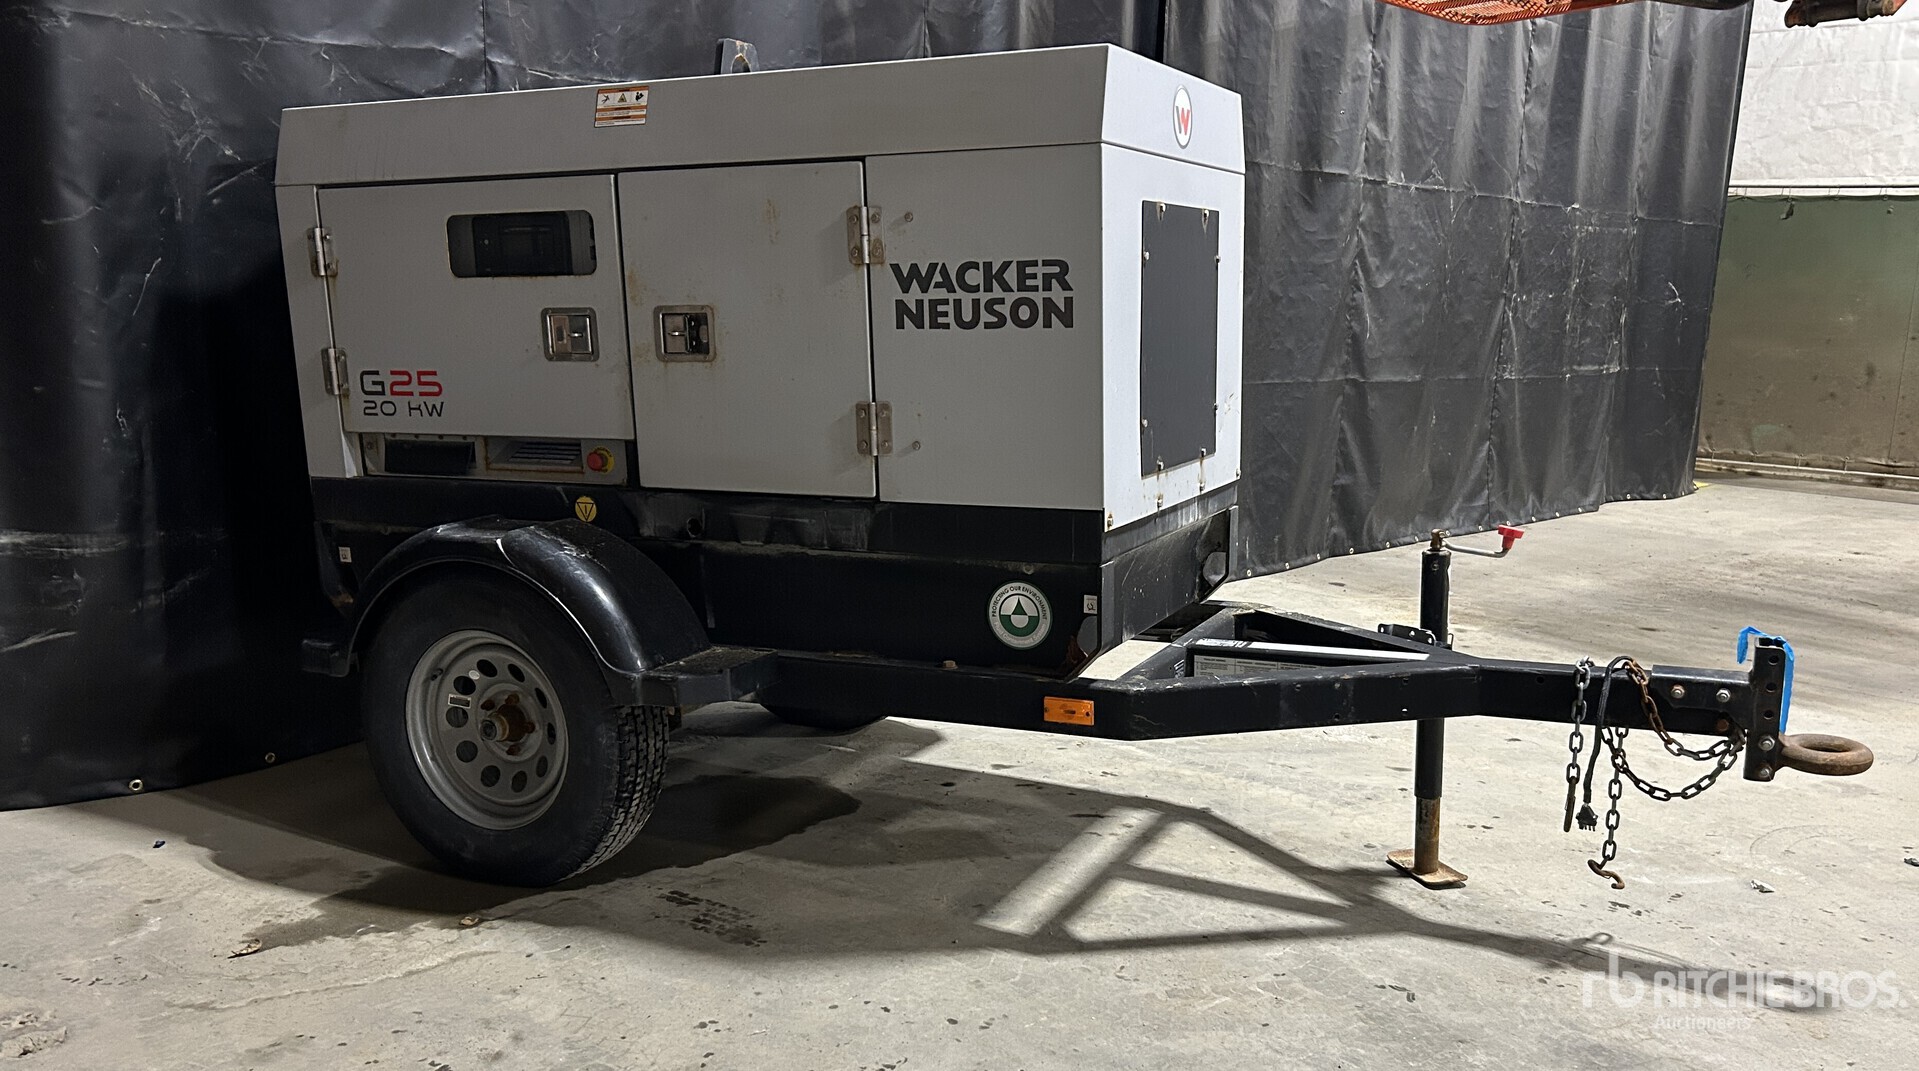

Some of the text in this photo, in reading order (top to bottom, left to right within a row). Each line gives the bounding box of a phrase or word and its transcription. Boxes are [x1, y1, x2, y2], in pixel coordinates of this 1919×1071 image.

[890, 259, 1074, 293] WACKER
[895, 296, 1075, 330] NEUSON
[360, 369, 443, 397] G25
[363, 400, 397, 417] 20
[992, 588, 1010, 617] PROTECTING
[1022, 586, 1048, 620] ENVIRONMENT
